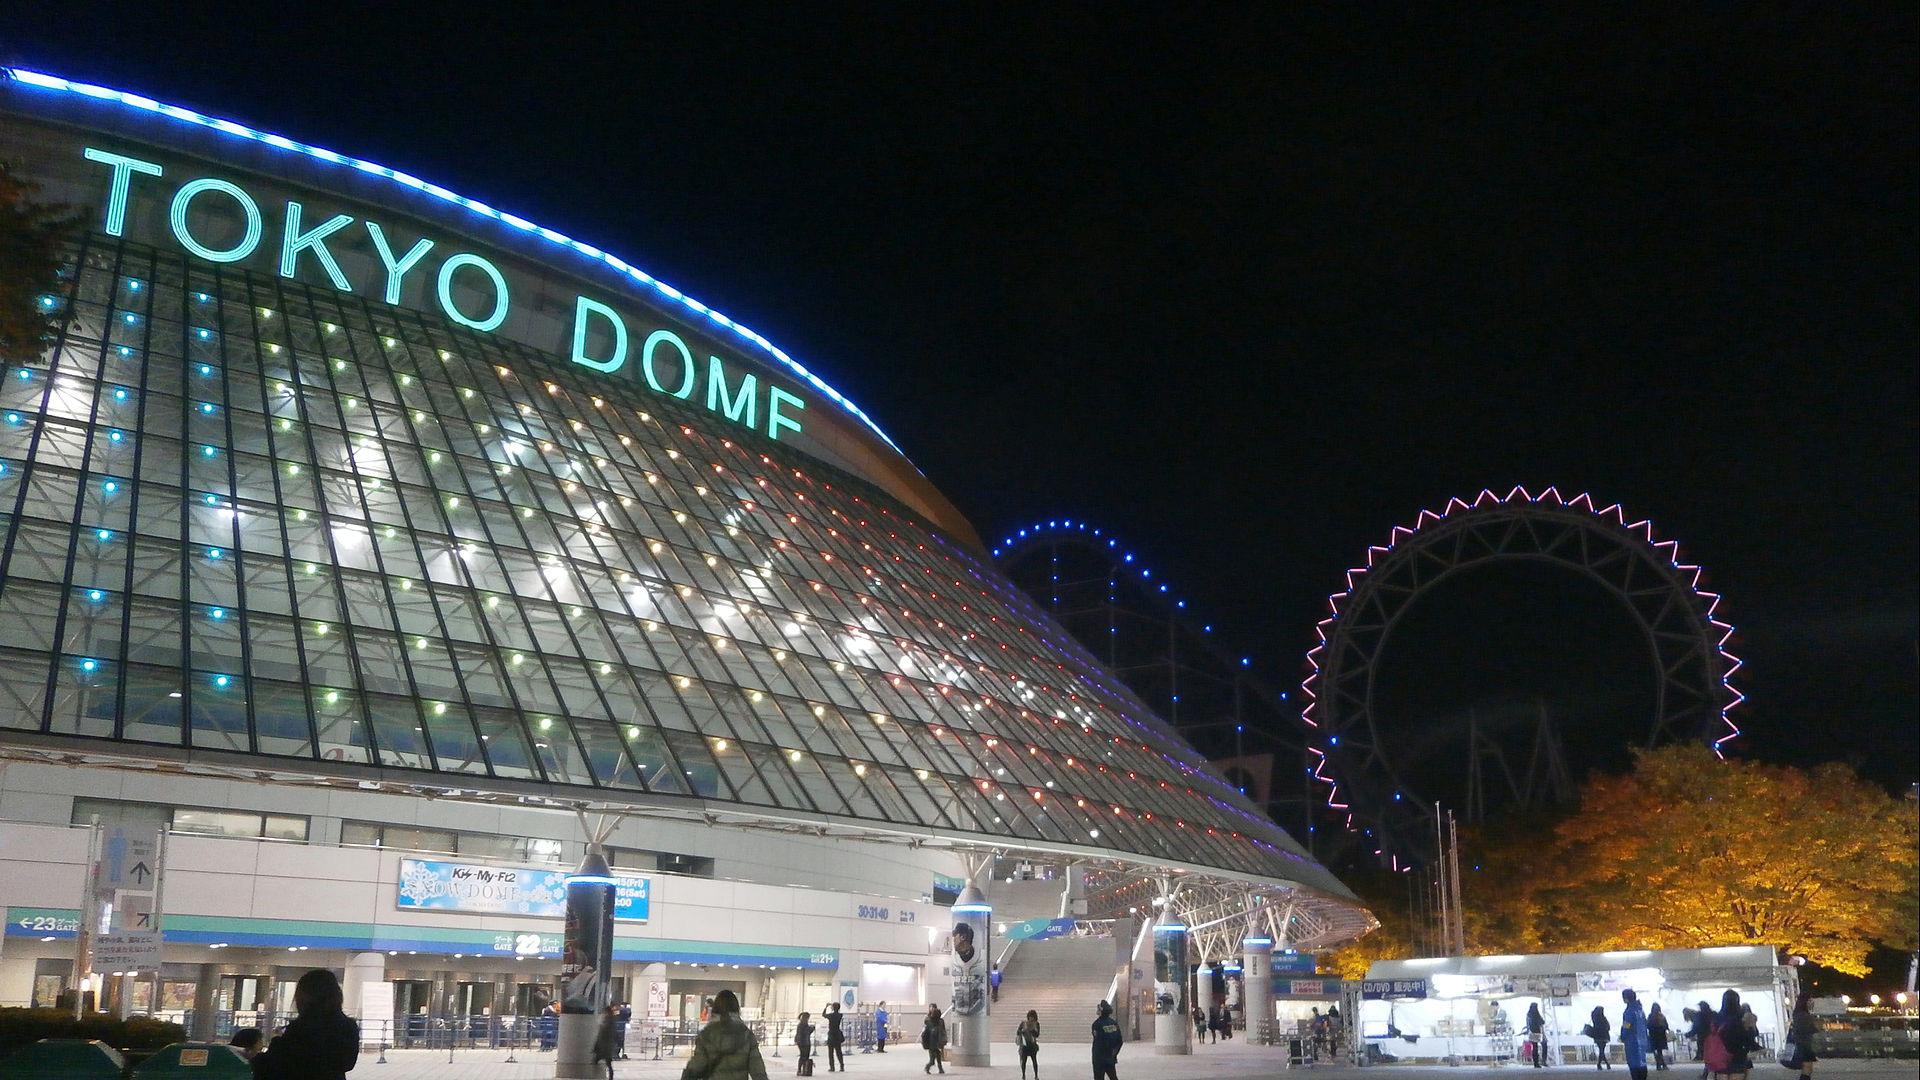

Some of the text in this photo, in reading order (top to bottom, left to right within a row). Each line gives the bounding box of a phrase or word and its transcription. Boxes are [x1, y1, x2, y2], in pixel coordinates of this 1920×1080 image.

[84, 147, 510, 332] TOKYO
[33, 916, 56, 931] 23
[493, 943, 513, 951] GATE
[515, 934, 541, 954] 22
[542, 945, 560, 953] GATE
[1363, 982, 1390, 993] CD/DVD
